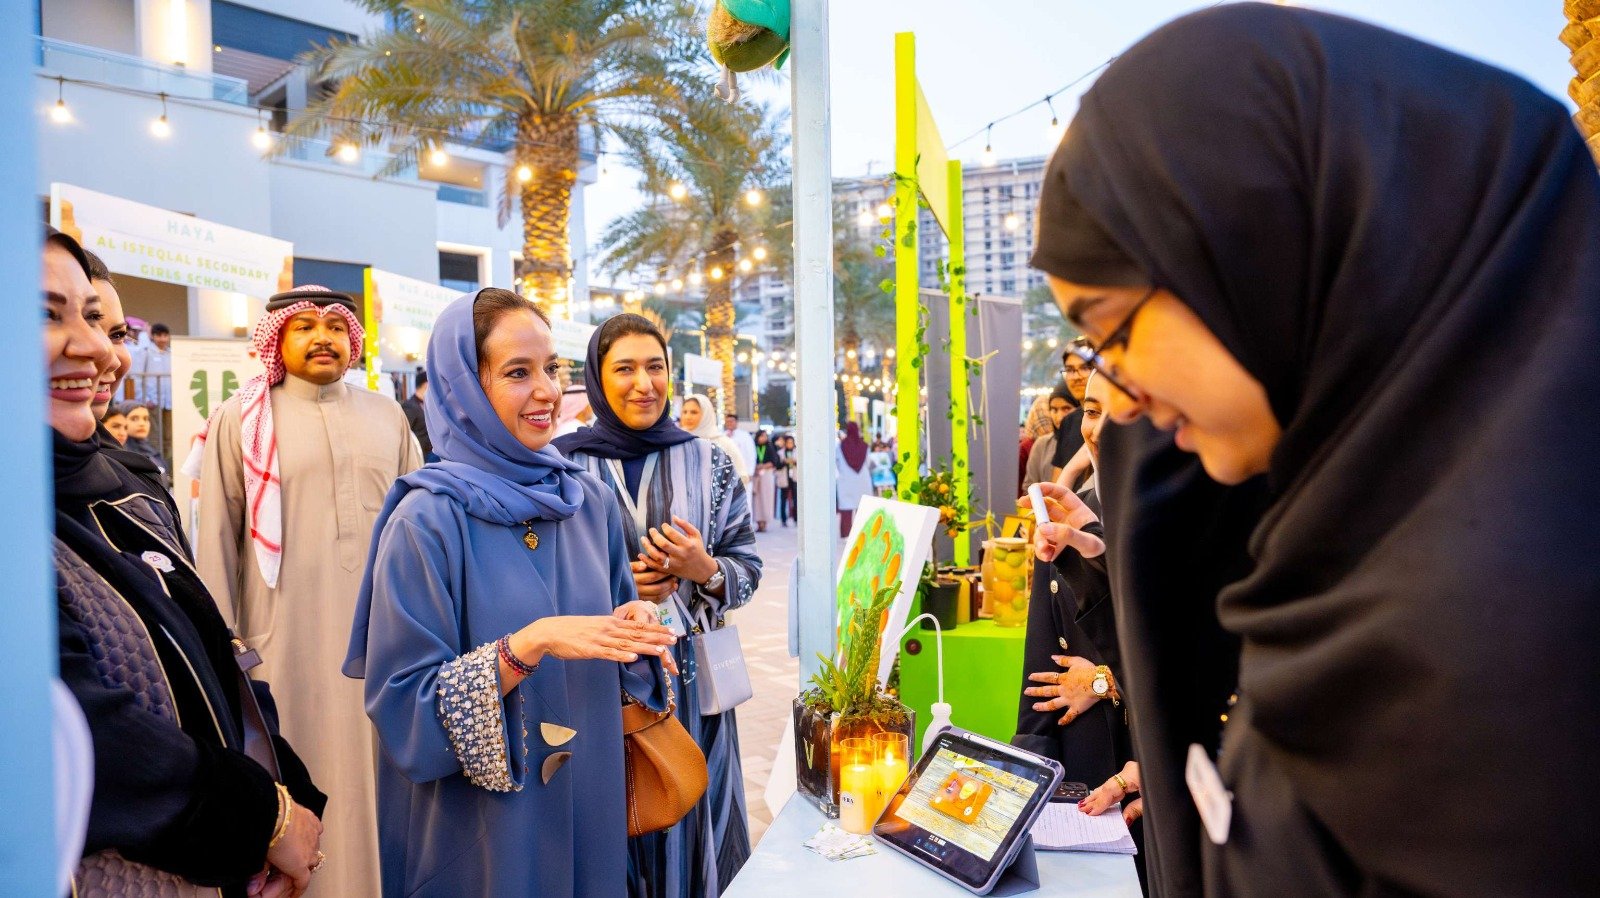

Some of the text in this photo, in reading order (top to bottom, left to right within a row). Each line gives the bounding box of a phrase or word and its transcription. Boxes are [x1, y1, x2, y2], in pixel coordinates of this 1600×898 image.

[167, 220, 216, 244] HAYA
[97, 235, 270, 281] AL ISTEQLAL SECONDARY
[141, 263, 238, 292] GIRLS SCHOOL
